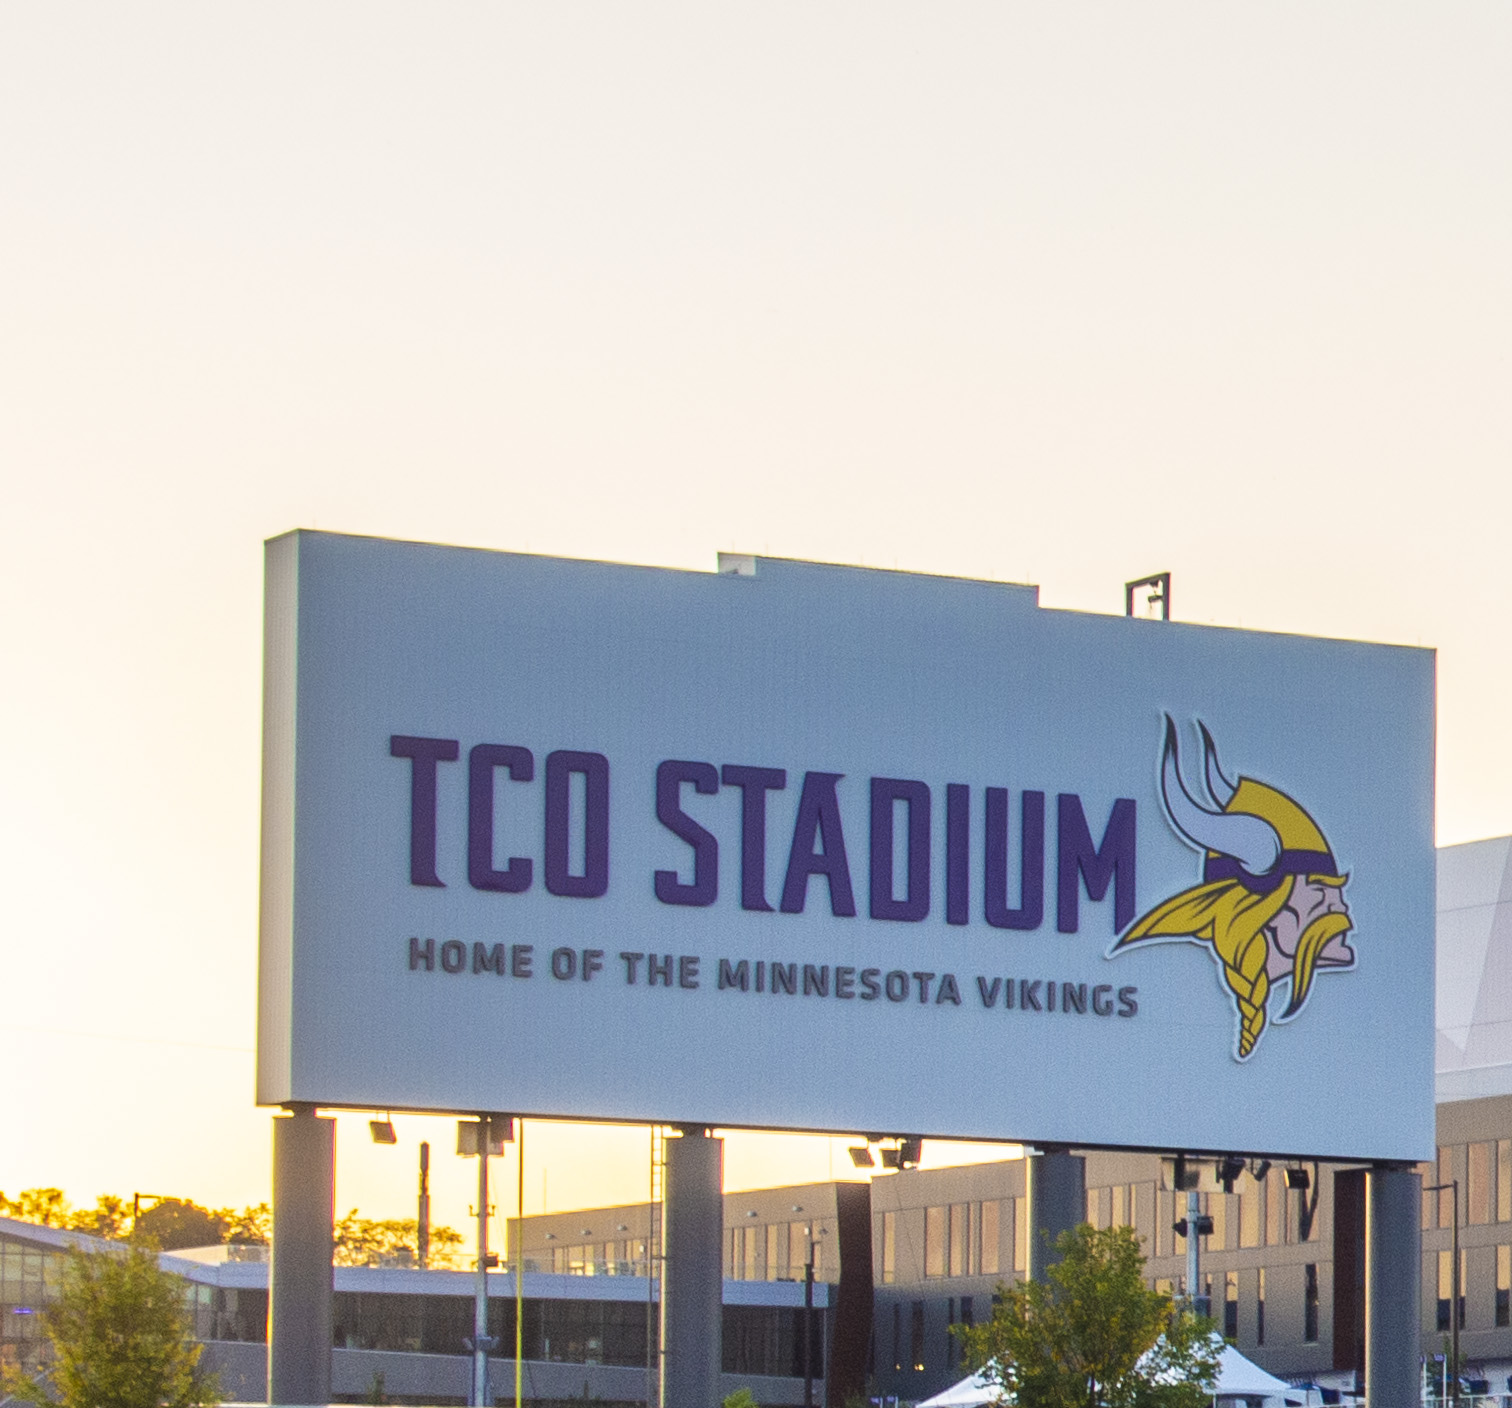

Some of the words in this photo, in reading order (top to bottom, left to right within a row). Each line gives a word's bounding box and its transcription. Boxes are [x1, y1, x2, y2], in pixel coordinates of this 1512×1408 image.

[390, 735, 609, 898] TCO
[655, 759, 1136, 935] STADIUM
[408, 937, 534, 979] HOME
[551, 946, 604, 981] OF
[620, 951, 700, 989] THE
[717, 958, 962, 1006] MINNESOTA
[976, 975, 1140, 1018] VIKINGS
